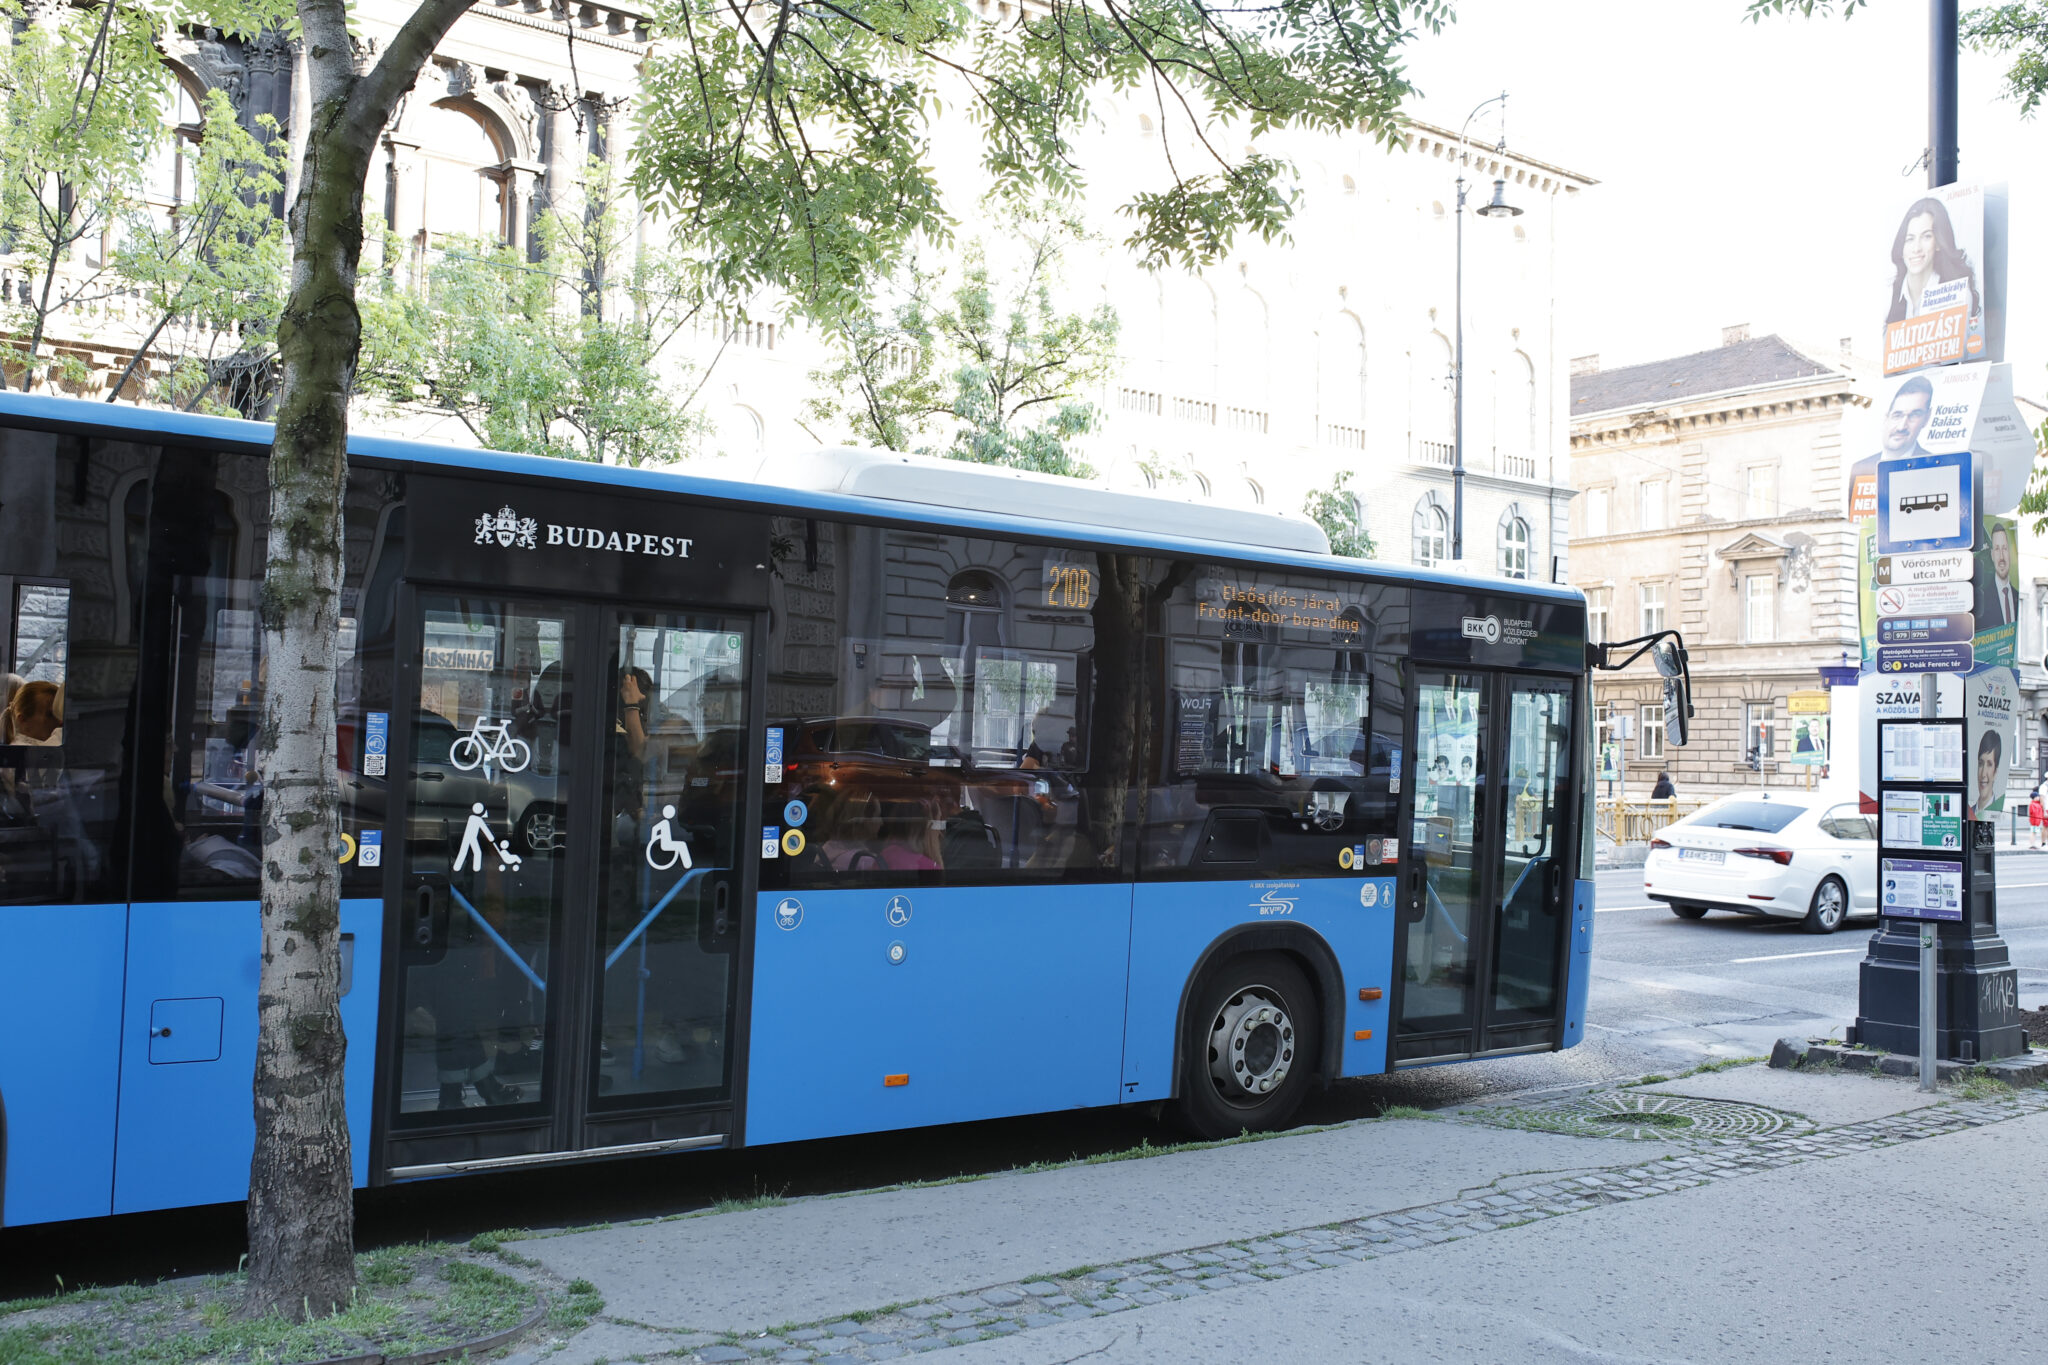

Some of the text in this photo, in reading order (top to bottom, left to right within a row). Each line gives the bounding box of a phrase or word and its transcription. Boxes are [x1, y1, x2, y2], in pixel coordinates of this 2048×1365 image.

[1923, 280, 1967, 298] Szentkirályi
[1922, 293, 1957, 307] Alexandra
[1890, 312, 1963, 351] VÁLTOZÁST
[1887, 337, 1961, 371] BUDAPESTEN!
[1935, 402, 1969, 415] Kovács
[1931, 415, 1962, 428] Balázs
[1927, 427, 1967, 440] Norbert
[546, 524, 693, 558] BUDAPEST
[1901, 556, 1963, 569] Vörösmarty
[1879, 566, 1951, 580] M utca M
[1048, 566, 1091, 608] 210B
[1223, 585, 1340, 611] Elsőajtós járat
[1199, 603, 1359, 633] Front-door boarding
[1503, 618, 1533, 628] BUDAPESTI
[1467, 623, 1484, 633] BKK
[1503, 628, 1538, 638] KÖZLEKEDÉSI
[1503, 636, 1528, 645] KÖZPONT
[1972, 633, 1996, 647] OPRONI
[424, 648, 493, 669] ÁBSZÍNHÁZ
[1876, 692, 1942, 705] SZAVAZ
[1978, 695, 2011, 711] SZAVAZZ
[1882, 706, 1907, 714] KÖZÖS
